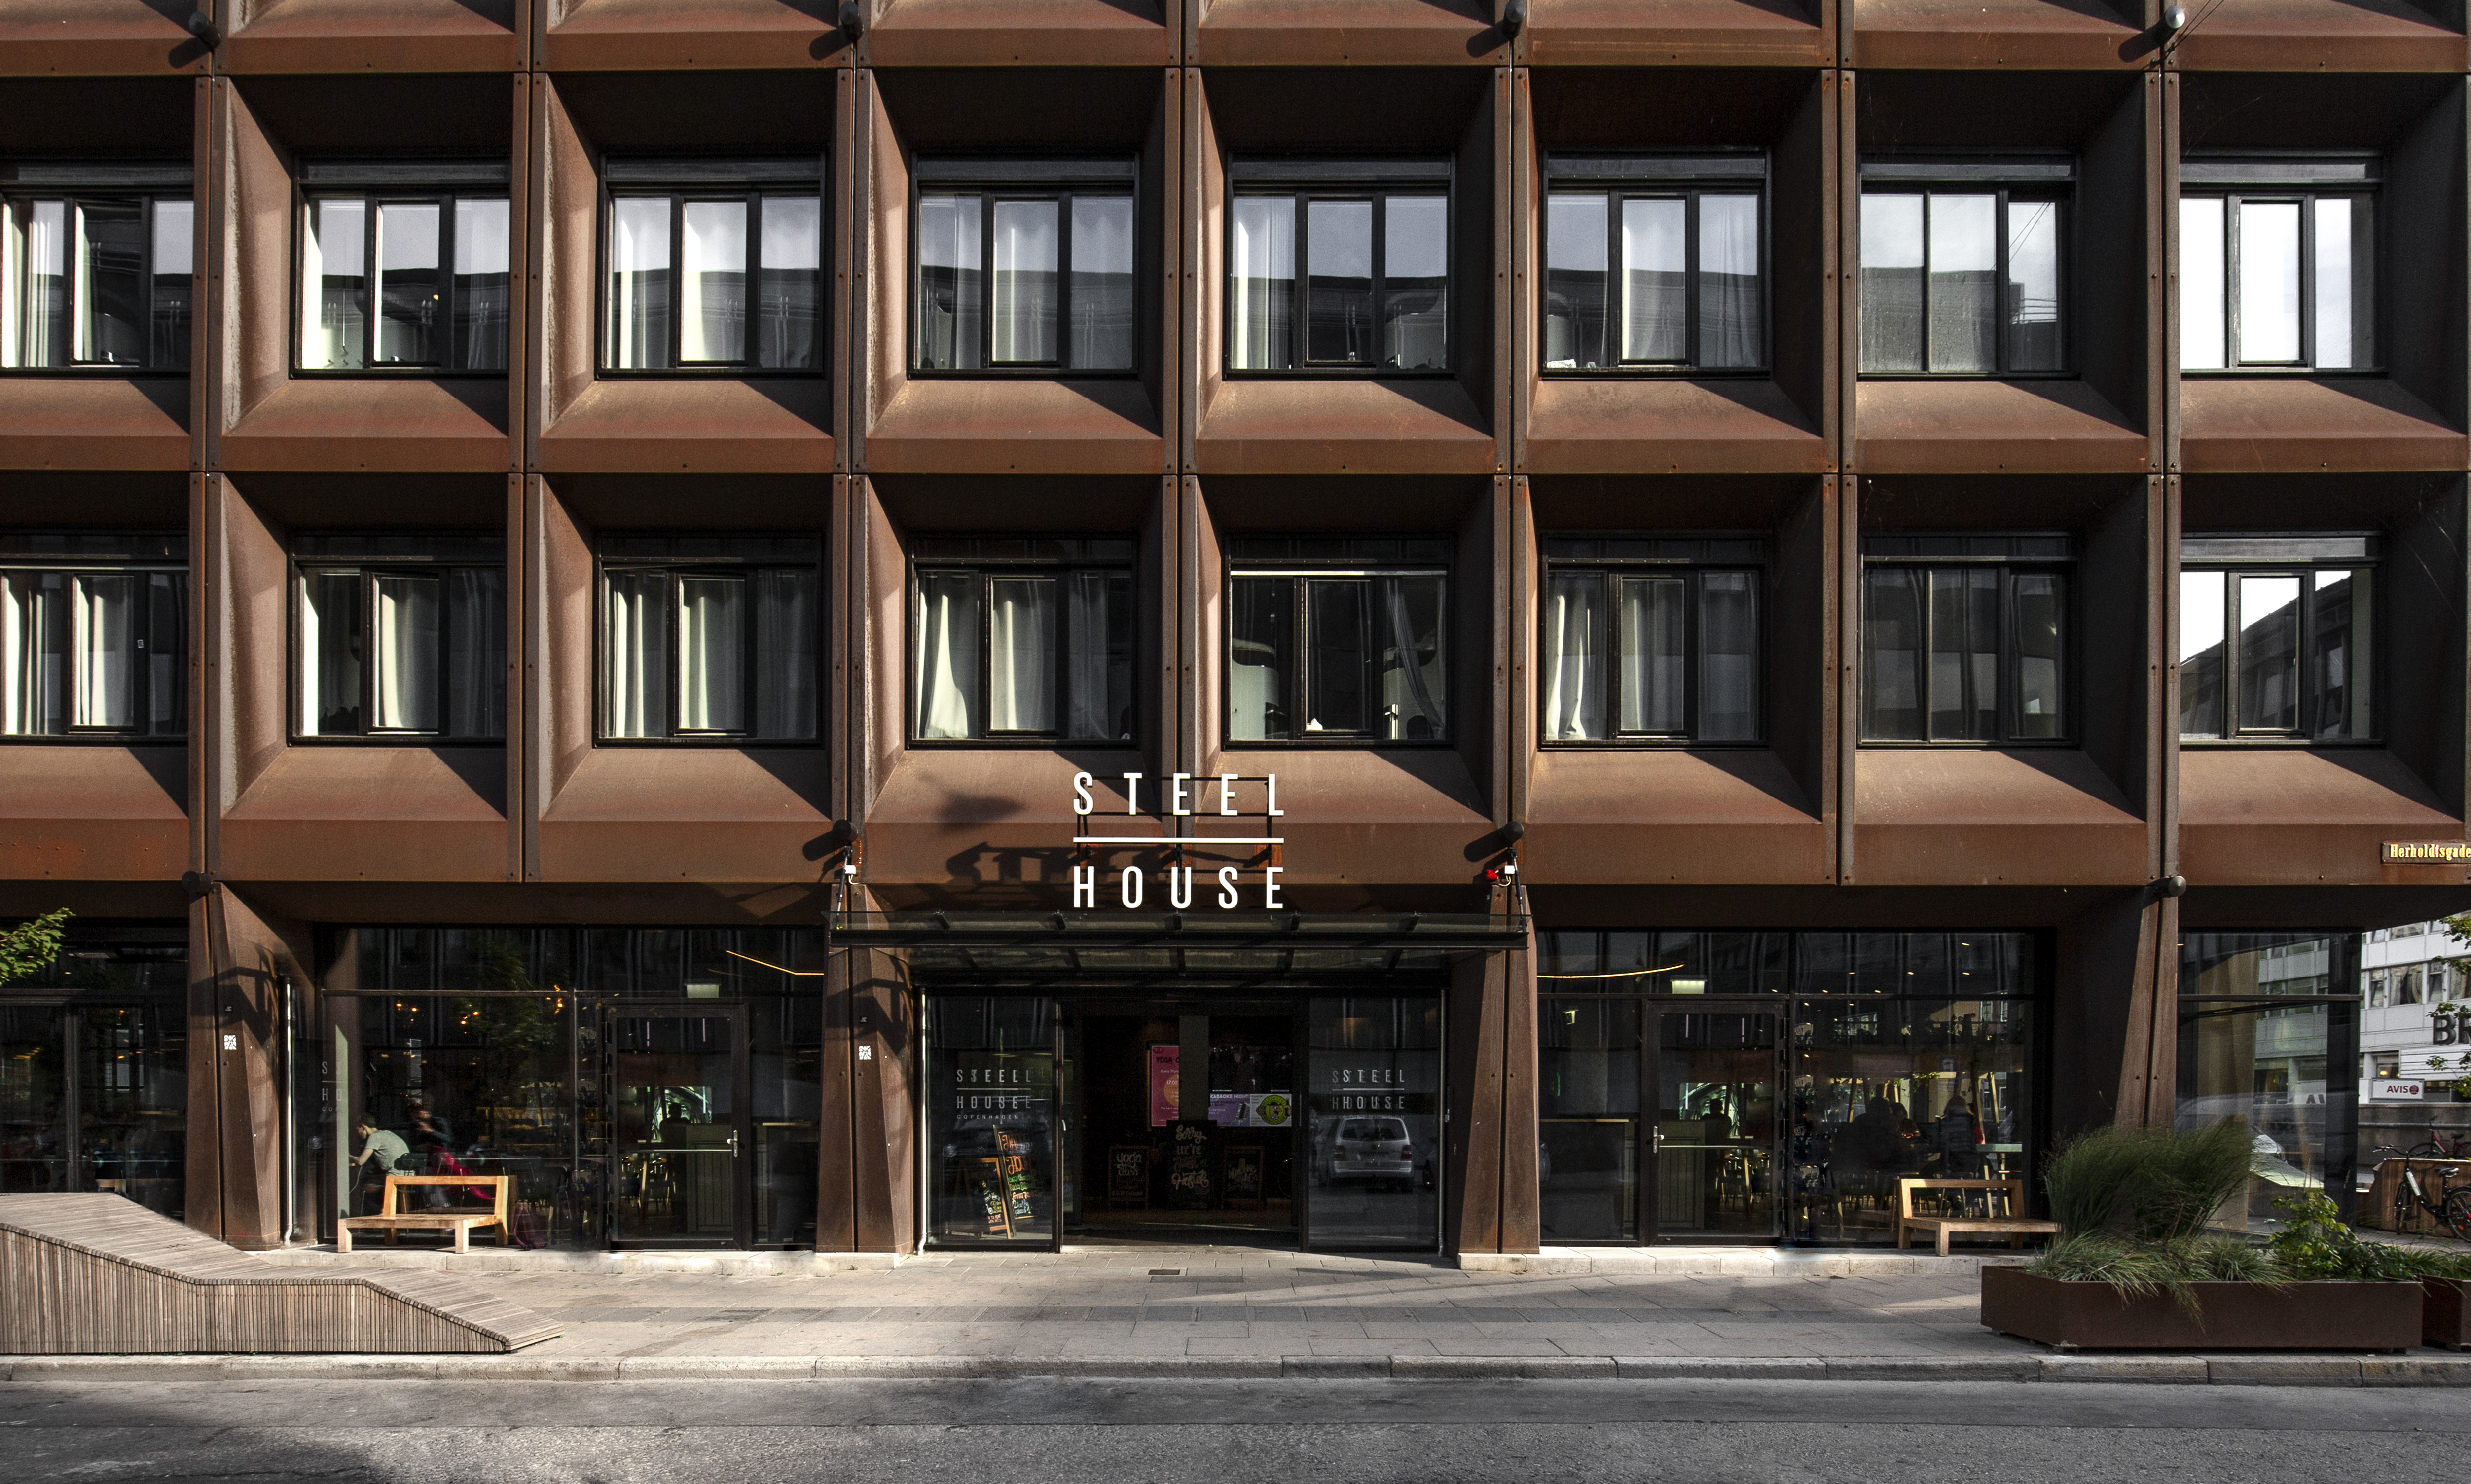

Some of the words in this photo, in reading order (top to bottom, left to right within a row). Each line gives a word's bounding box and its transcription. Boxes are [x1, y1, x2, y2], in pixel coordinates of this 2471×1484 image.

[1073, 772, 1284, 816] STEEL
[2390, 844, 2471, 861] Herholdtsgade
[1073, 866, 1283, 908] HOUSE
[2387, 1085, 2408, 1093] AVIS
